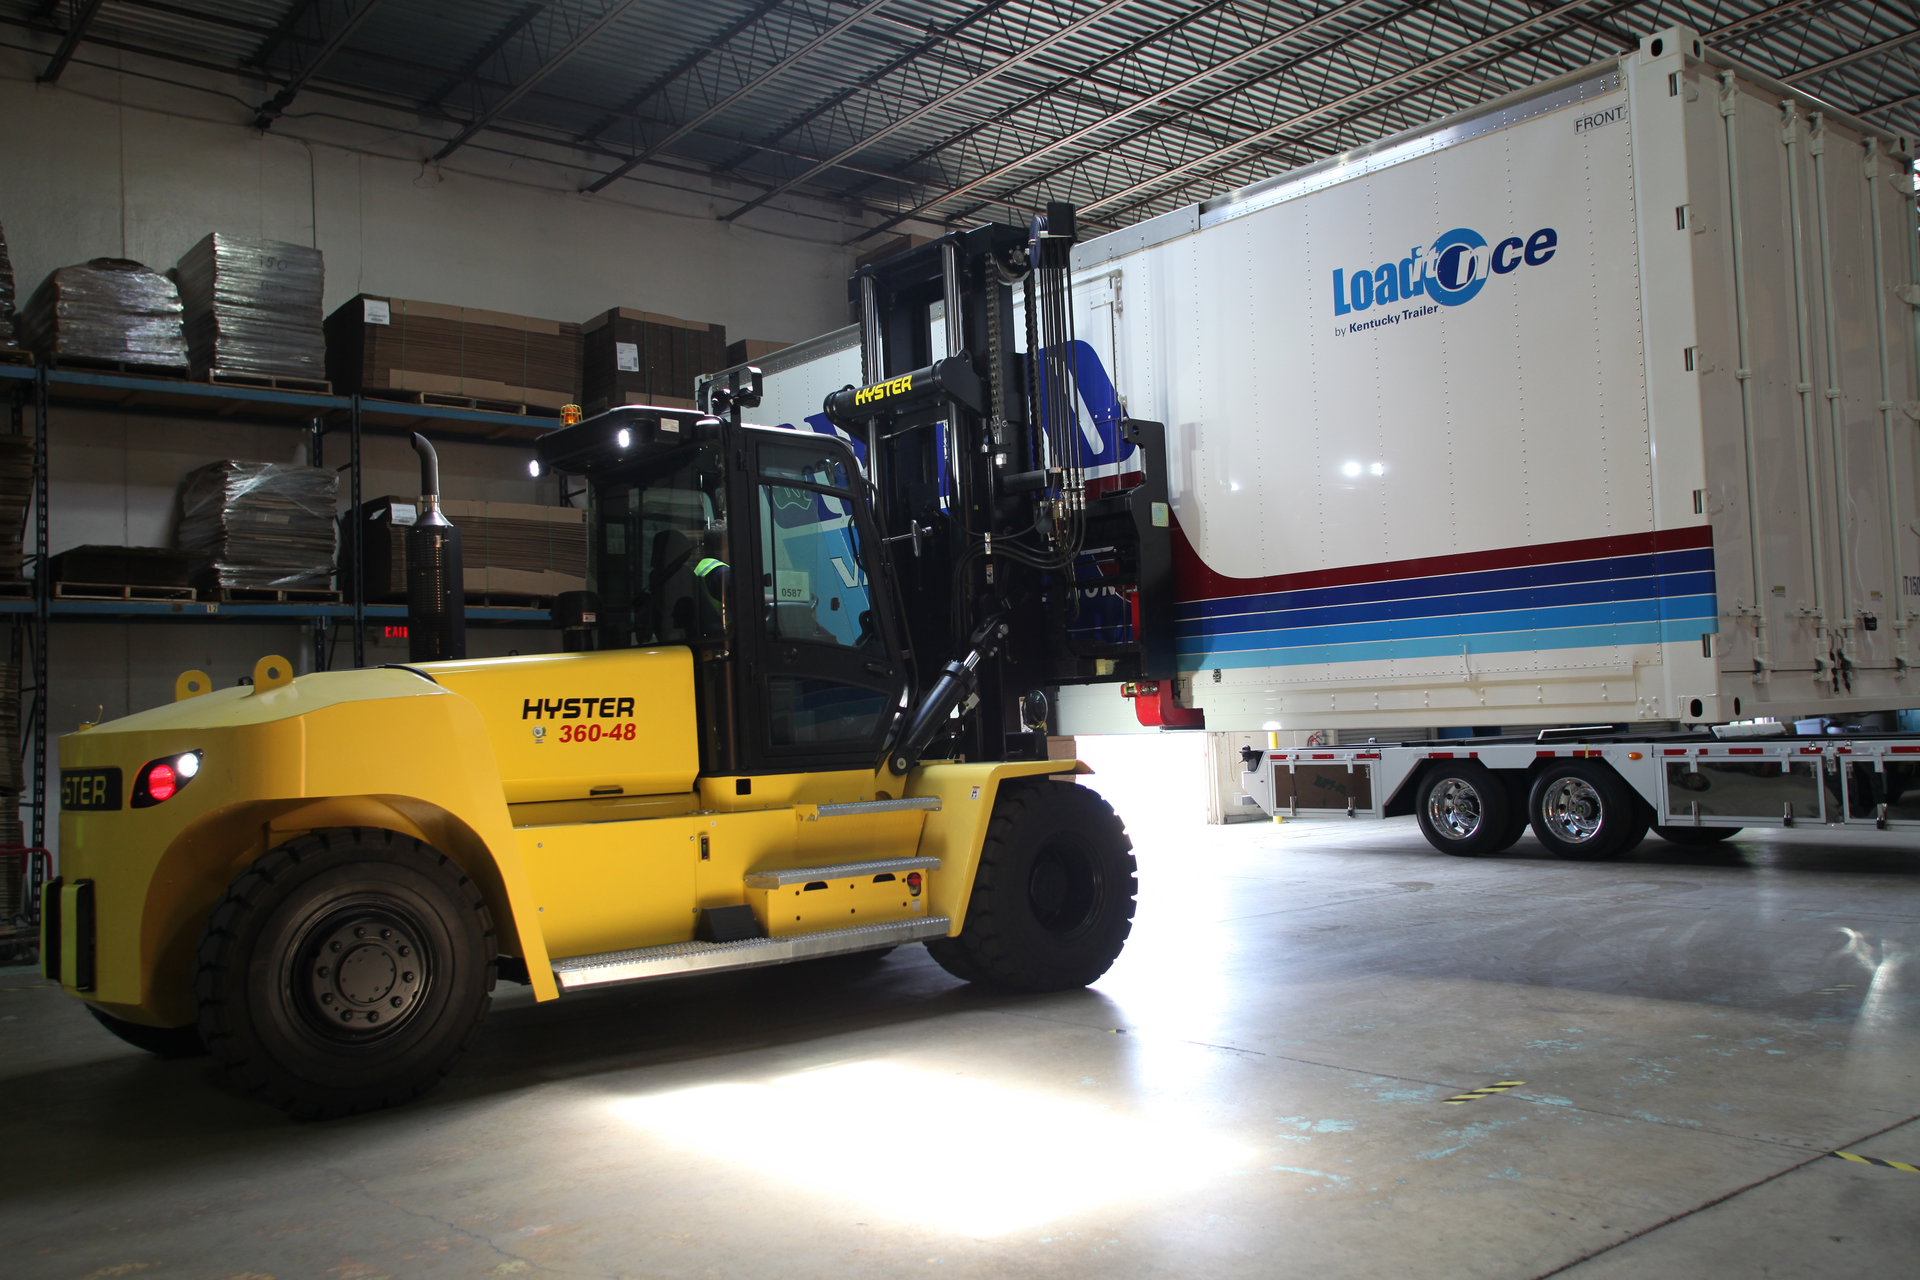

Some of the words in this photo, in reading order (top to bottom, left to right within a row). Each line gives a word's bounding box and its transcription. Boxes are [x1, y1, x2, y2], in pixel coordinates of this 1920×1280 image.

[1575, 106, 1624, 133] FRONT
[1335, 326, 1347, 338] by
[1349, 313, 1401, 334] Kentucky
[1402, 304, 1439, 321] Trailer
[855, 374, 913, 406] HYSTER
[781, 588, 802, 598] 0587
[522, 697, 635, 720] HYSTER
[558, 723, 637, 743] 360-48
[62, 775, 107, 805] STER
